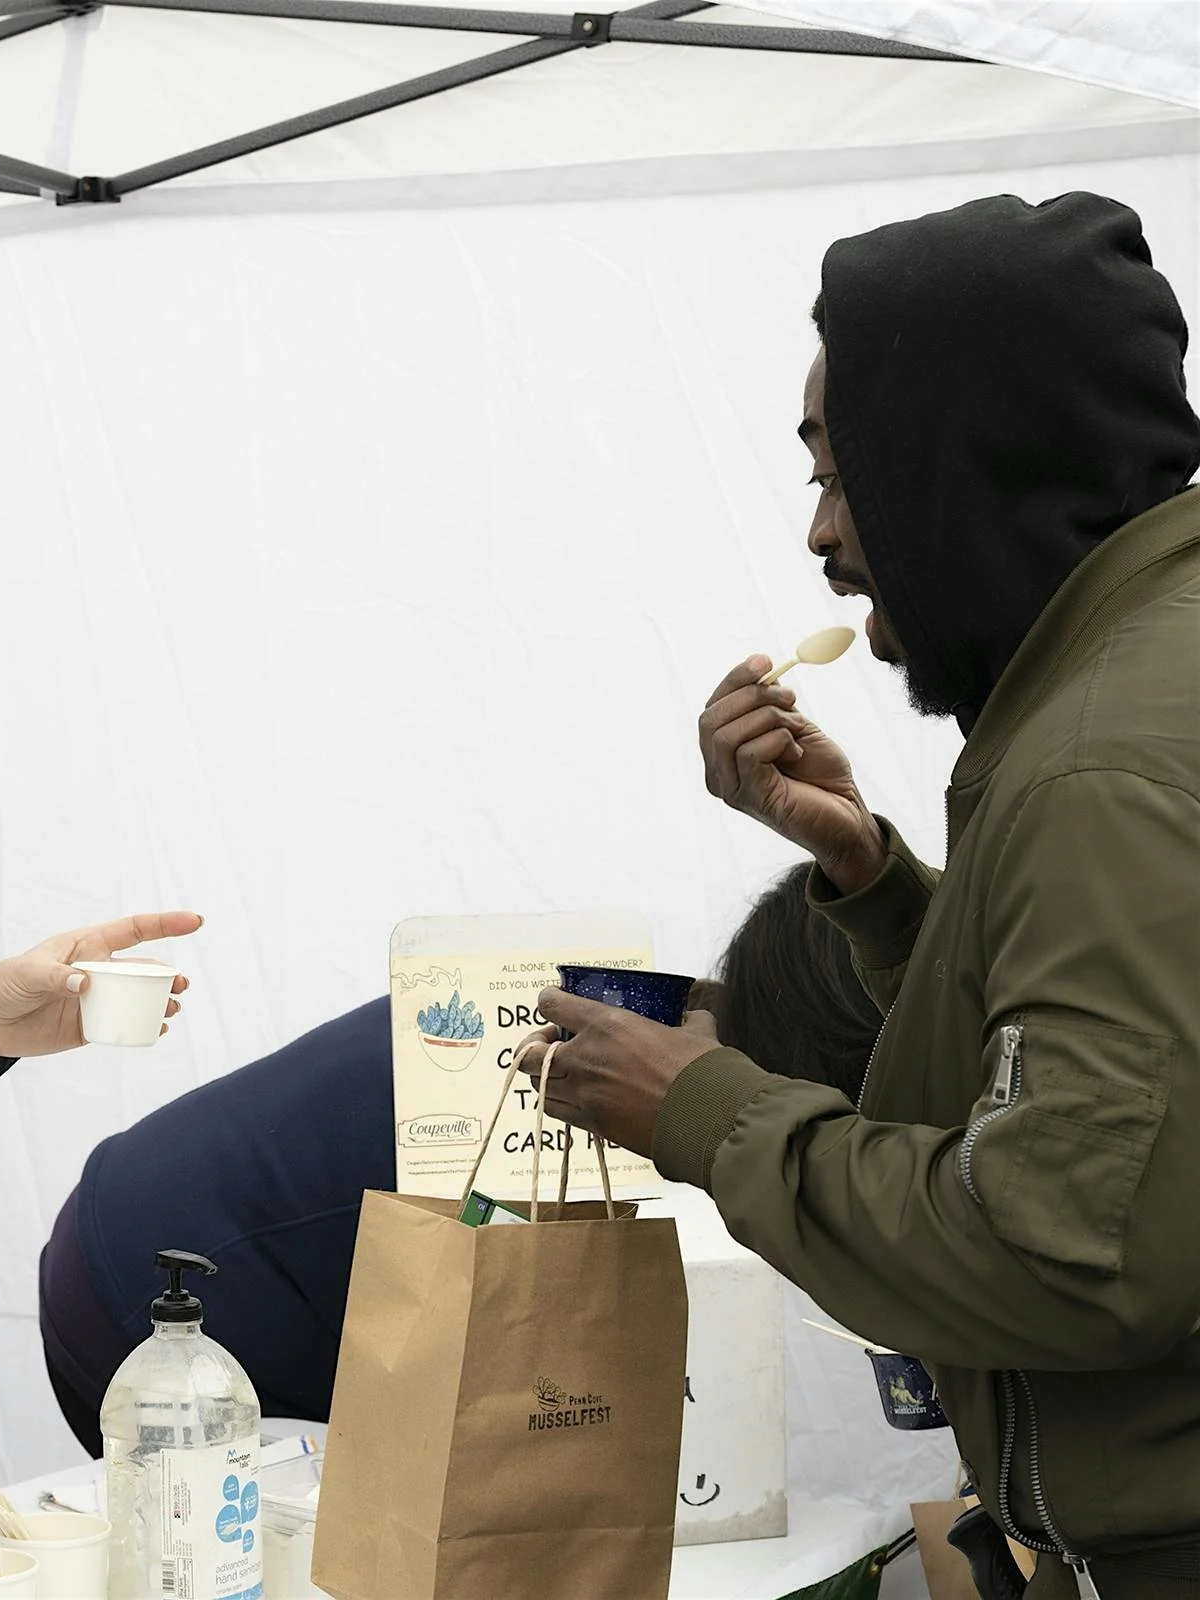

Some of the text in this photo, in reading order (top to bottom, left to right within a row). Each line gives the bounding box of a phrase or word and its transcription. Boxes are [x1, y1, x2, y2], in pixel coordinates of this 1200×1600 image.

[501, 964, 518, 973] ALL
[520, 962, 546, 972] DONE
[489, 981, 507, 991] DID
[509, 980, 529, 989] YOU
[408, 1120, 472, 1138] Coupeville
[503, 1129, 574, 1153] CARD
[528, 1405, 612, 1431] MUSSELFEST
[215, 1569, 238, 1585] hand
